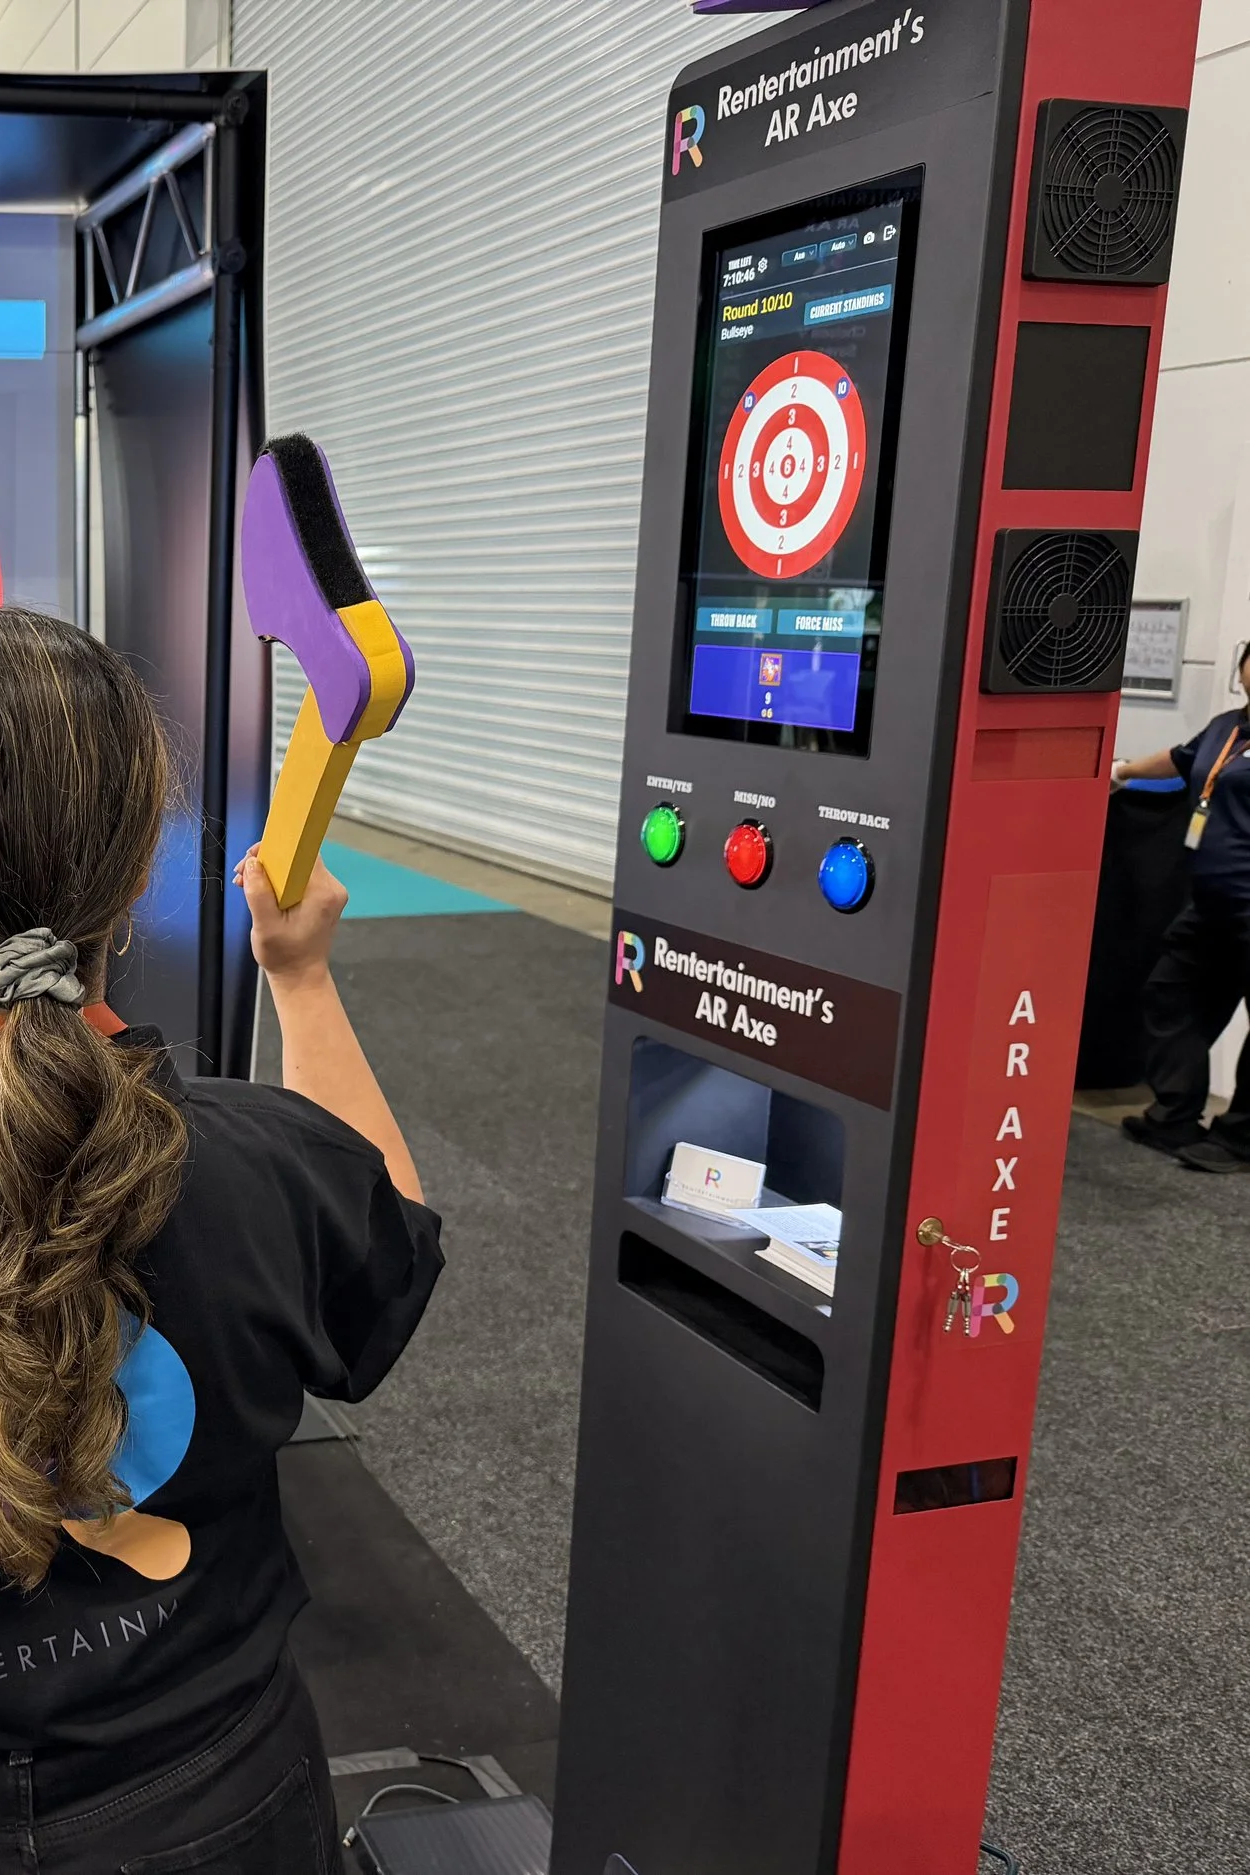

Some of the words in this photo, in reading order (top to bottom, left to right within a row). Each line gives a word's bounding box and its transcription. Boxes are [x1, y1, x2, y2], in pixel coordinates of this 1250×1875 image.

[717, 8, 925, 120] Rentertainment's
[764, 103, 800, 147] AR
[806, 91, 858, 132] Axe
[672, 104, 705, 176] R
[831, 241, 846, 253] Auto
[723, 271, 756, 287] 7:10:46
[722, 300, 758, 322] Round
[760, 292, 794, 314] 10/10
[810, 302, 842, 320] CURRENT
[843, 292, 885, 313] STANDINGS
[721, 323, 754, 341] Bullseye
[793, 357, 799, 374] 1
[791, 383, 798, 399] 2
[838, 381, 848, 395] 10
[744, 396, 754, 409] 10
[788, 408, 797, 425] 3
[786, 436, 793, 450] 4
[724, 463, 730, 479] 1
[738, 463, 745, 478] 2
[752, 461, 761, 478] 3
[769, 461, 776, 475] 4
[783, 459, 792, 474] 6
[799, 458, 806, 472] 4
[817, 455, 826, 472] 3
[834, 455, 841, 470] 2
[853, 452, 859, 469] 1
[782, 485, 789, 499] 4
[779, 509, 788, 526] 3
[778, 535, 785, 550] 2
[776, 559, 783, 576] 1
[710, 613, 735, 629] THROW
[736, 614, 757, 629] BACK
[795, 615, 821, 631] FORCE
[822, 616, 843, 632] MISS
[646, 775, 693, 794] ENTER/YES
[734, 790, 776, 809] MISS/NO
[818, 805, 859, 824] THROW
[859, 812, 890, 830] BACK
[615, 930, 645, 993] R
[653, 936, 836, 1025] Rentertainment's
[695, 991, 727, 1029] AR
[731, 1003, 778, 1048] Axe
[705, 1167, 722, 1189] R
[970, 1272, 1019, 1338] R
